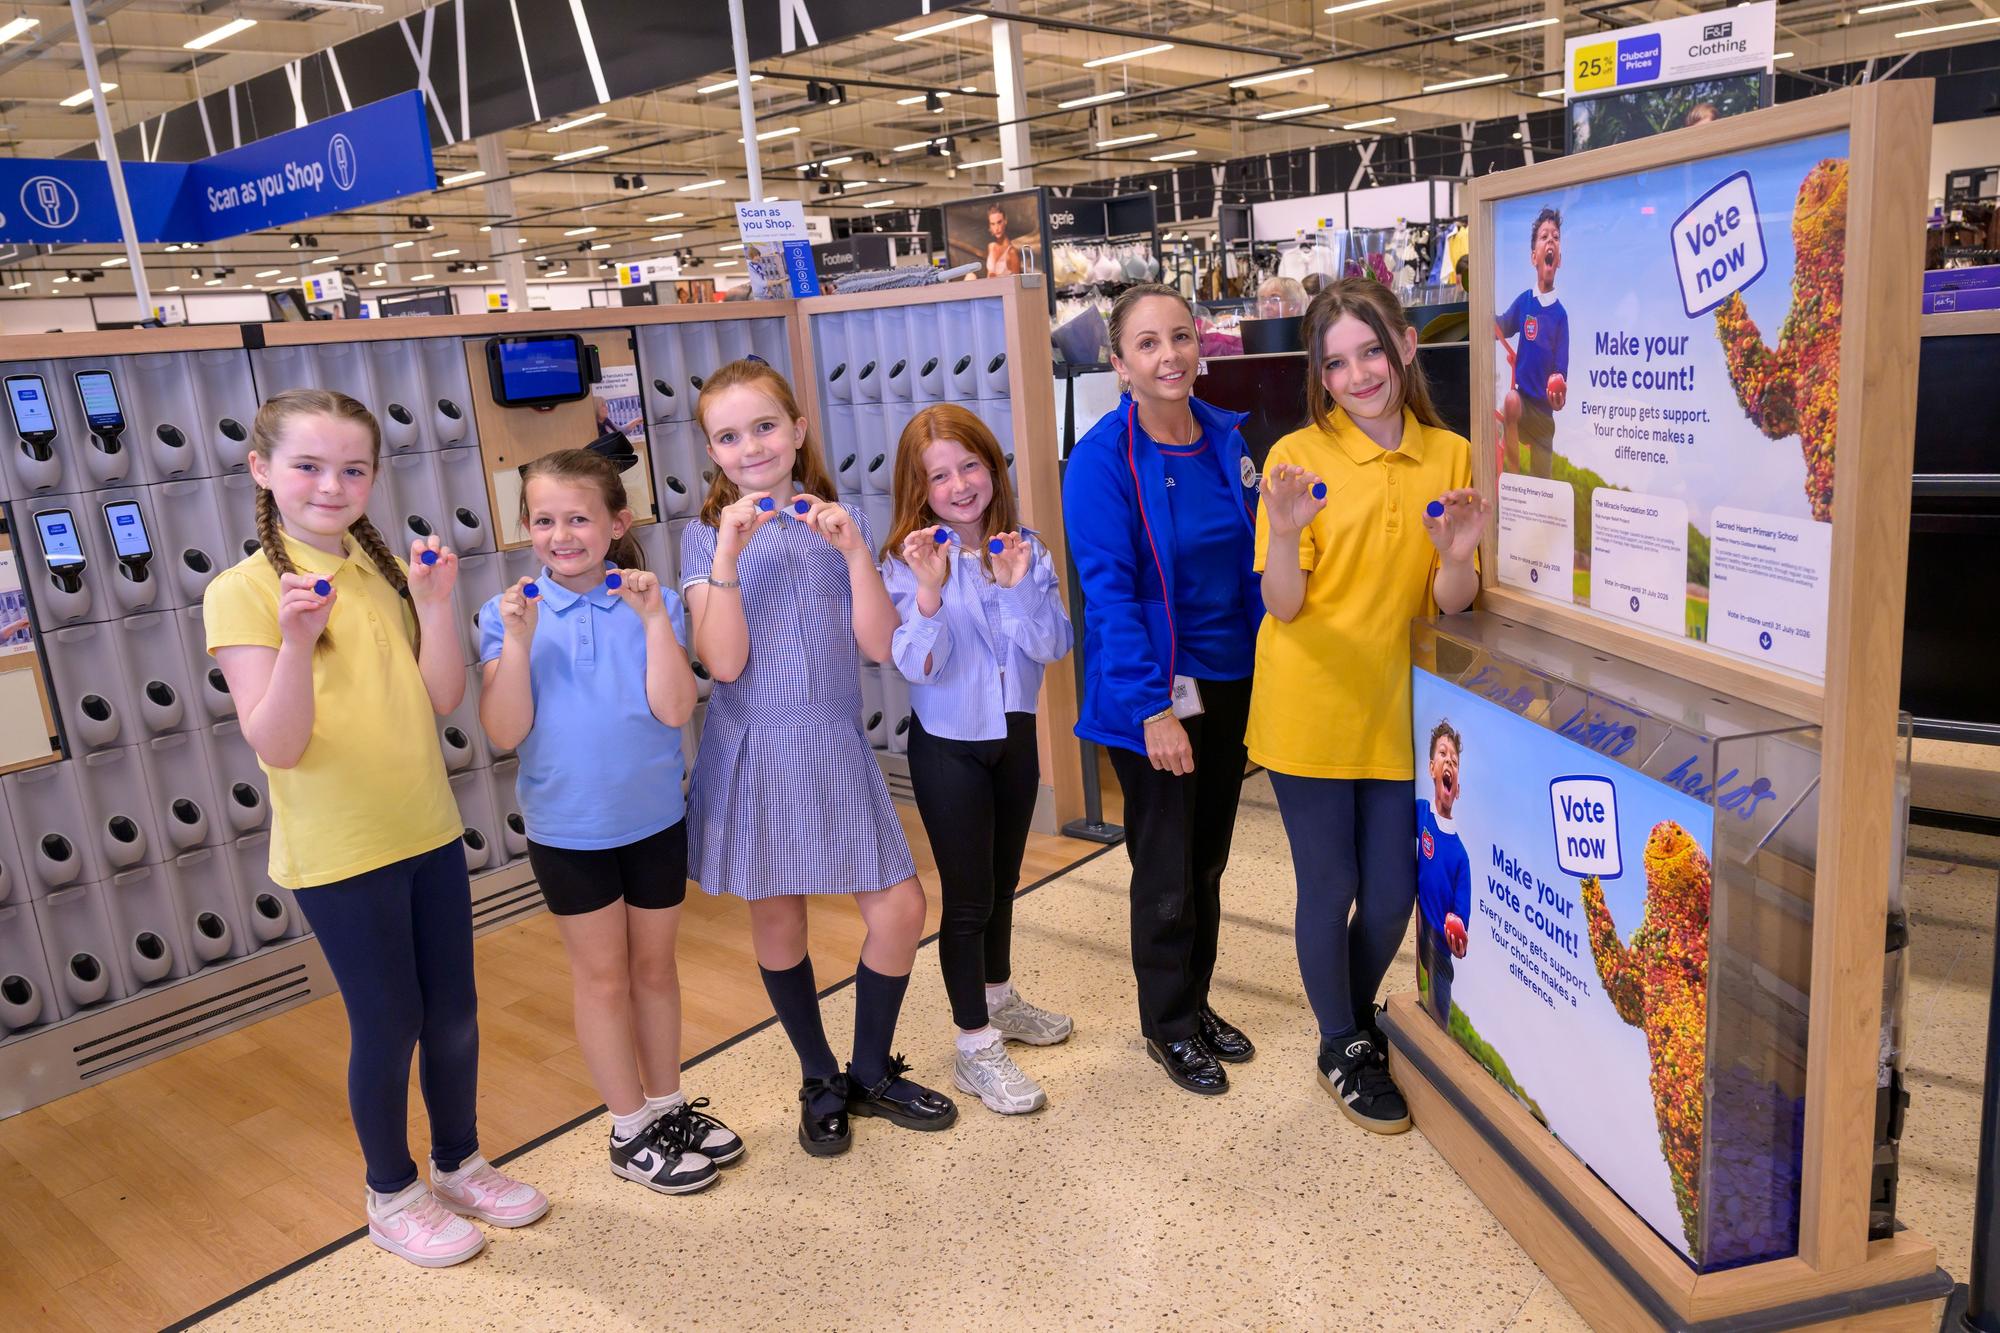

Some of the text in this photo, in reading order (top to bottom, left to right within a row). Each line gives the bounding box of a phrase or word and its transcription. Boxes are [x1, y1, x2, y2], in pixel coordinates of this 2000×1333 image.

[1704, 23, 1732, 39] F&F
[1620, 48, 1659, 62] Clubcard
[1689, 39, 1747, 58] Clothing
[1578, 58, 1602, 78] 25
[1626, 59, 1652, 70] Prices
[207, 161, 324, 213] Scan as you Shop
[740, 208, 766, 218] Scan
[743, 222, 762, 232] you
[765, 219, 794, 230] Shop.
[1686, 206, 1740, 256] Vote
[1696, 242, 1744, 294] now
[1595, 331, 1689, 362] Make your
[1590, 365, 1694, 391] vote count!
[1582, 401, 1710, 424] Every group gets support.
[1594, 422, 1694, 445] Your choice makes a
[1614, 446, 1668, 464] difference.
[1526, 488, 1540, 496] Primary
[1541, 490, 1554, 498] School
[1604, 502, 1620, 510] Miracle
[1620, 504, 1646, 515] Foundation
[1716, 520, 1799, 542] Sacred Heart Primary School
[1614, 580, 1630, 591] in-store
[1728, 610, 1739, 620] Vote
[1740, 612, 1760, 626] in-store
[1762, 619, 1774, 629] until
[1775, 622, 1781, 630] 31
[1782, 624, 1794, 635] July
[1560, 795, 1605, 824] Vote
[1567, 836, 1606, 859] now
[1492, 844, 1574, 919] Make your
[1488, 875, 1578, 958] vote count!
[1480, 899, 1590, 997] Every group gets support.
[1491, 926, 1577, 1007] Your choice makes a
[1510, 963, 1556, 1010] difference.
